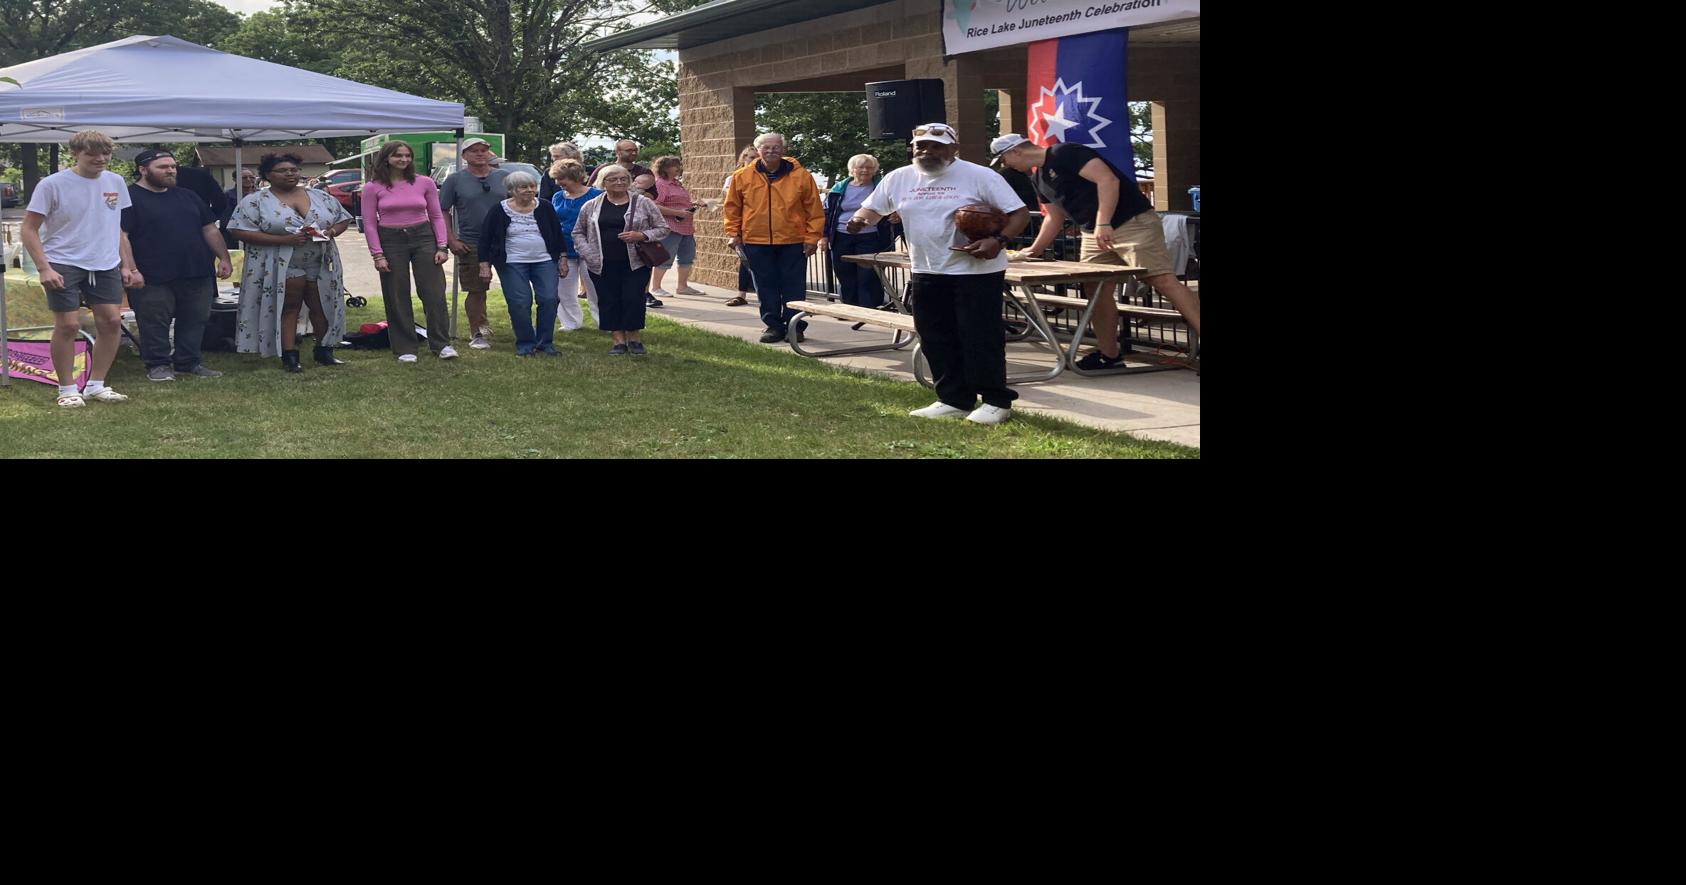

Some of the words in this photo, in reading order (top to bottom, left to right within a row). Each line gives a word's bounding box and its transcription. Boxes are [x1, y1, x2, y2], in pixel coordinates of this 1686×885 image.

[967, 27, 989, 38] Rice
[991, 21, 1016, 34] Lake
[1018, 9, 1081, 29] Juneteenth
[1085, 0, 1160, 18] Celebration
